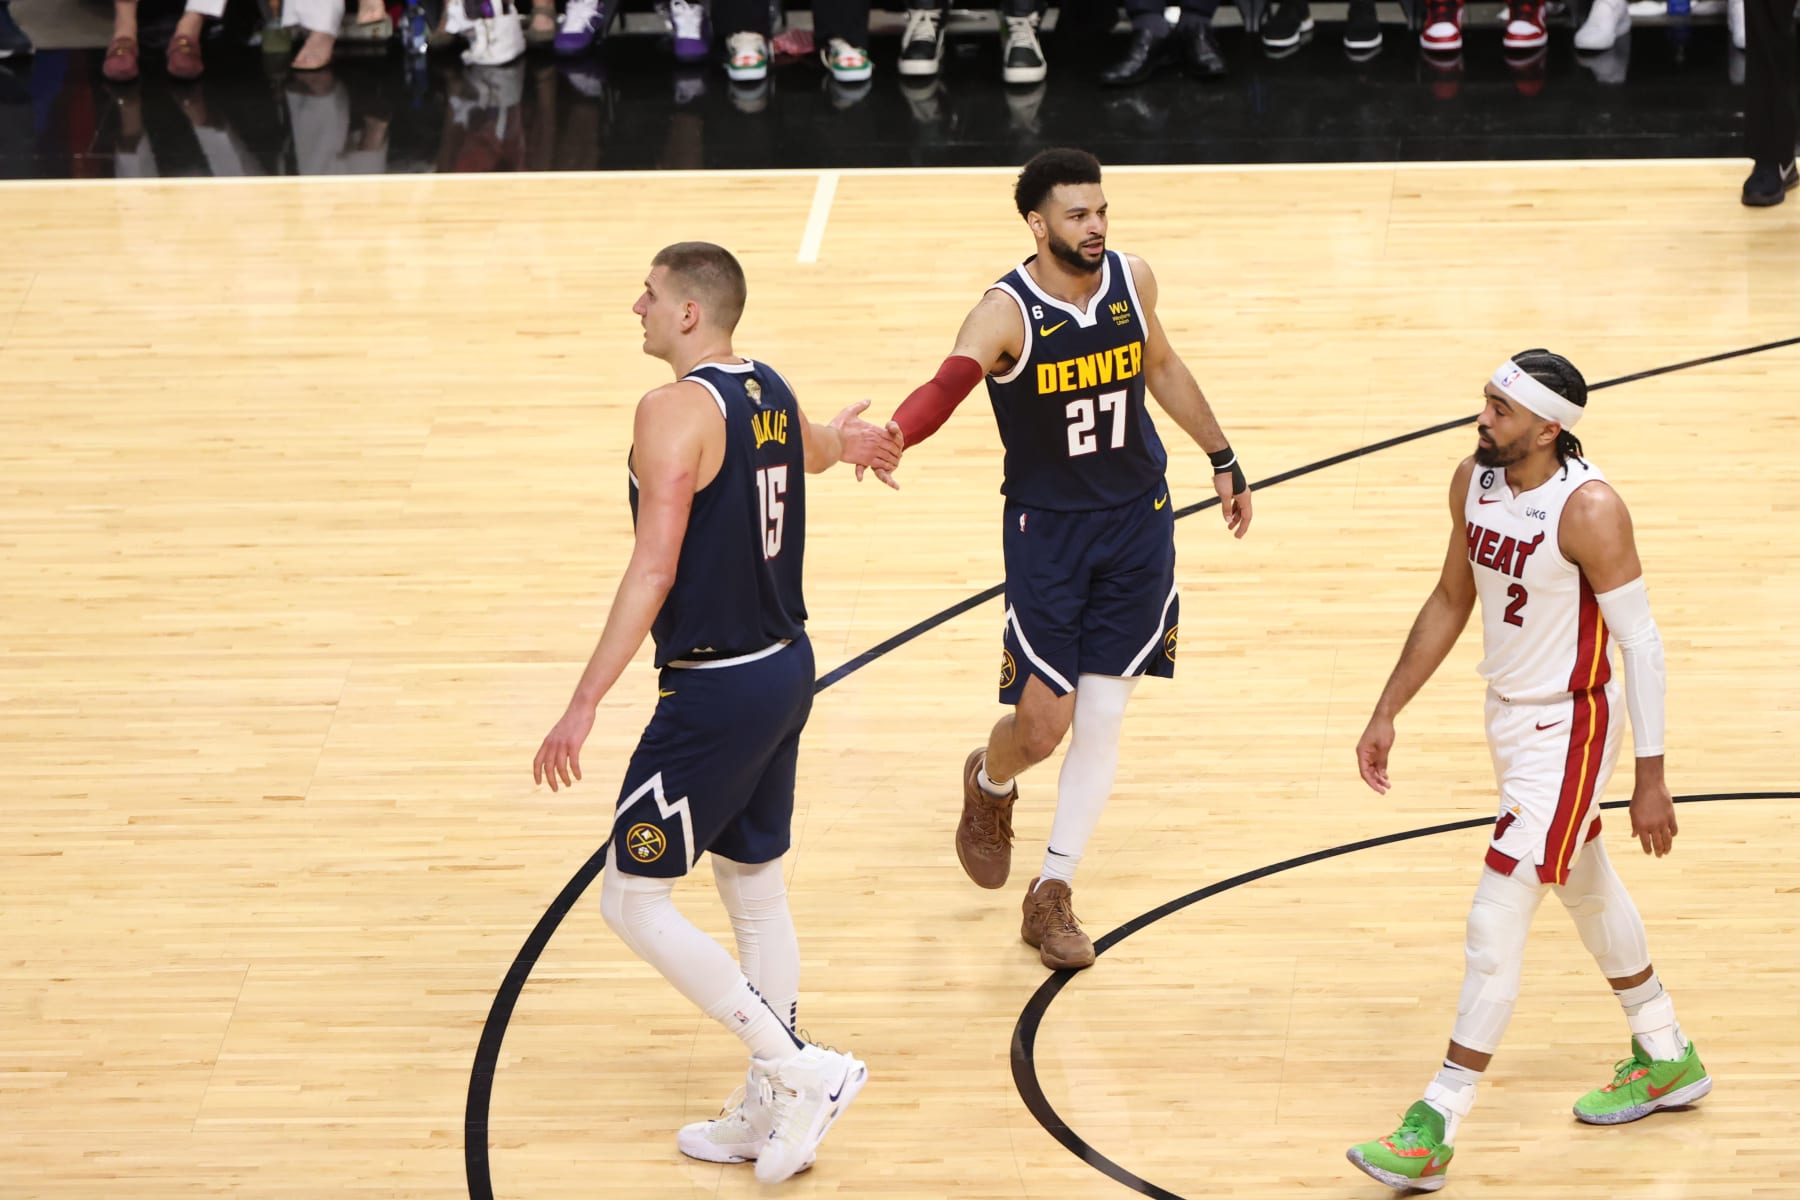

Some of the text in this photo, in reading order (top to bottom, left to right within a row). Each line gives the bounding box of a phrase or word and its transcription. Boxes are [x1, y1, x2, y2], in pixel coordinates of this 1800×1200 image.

[1031, 305, 1044, 320] 6
[1108, 300, 1128, 314] WU
[1036, 341, 1142, 395] DENVER
[1065, 388, 1128, 457] 27
[756, 464, 788, 561] 15
[1525, 507, 1546, 520] UKG
[1466, 520, 1545, 579] HEAT
[1503, 582, 1528, 627] 2
